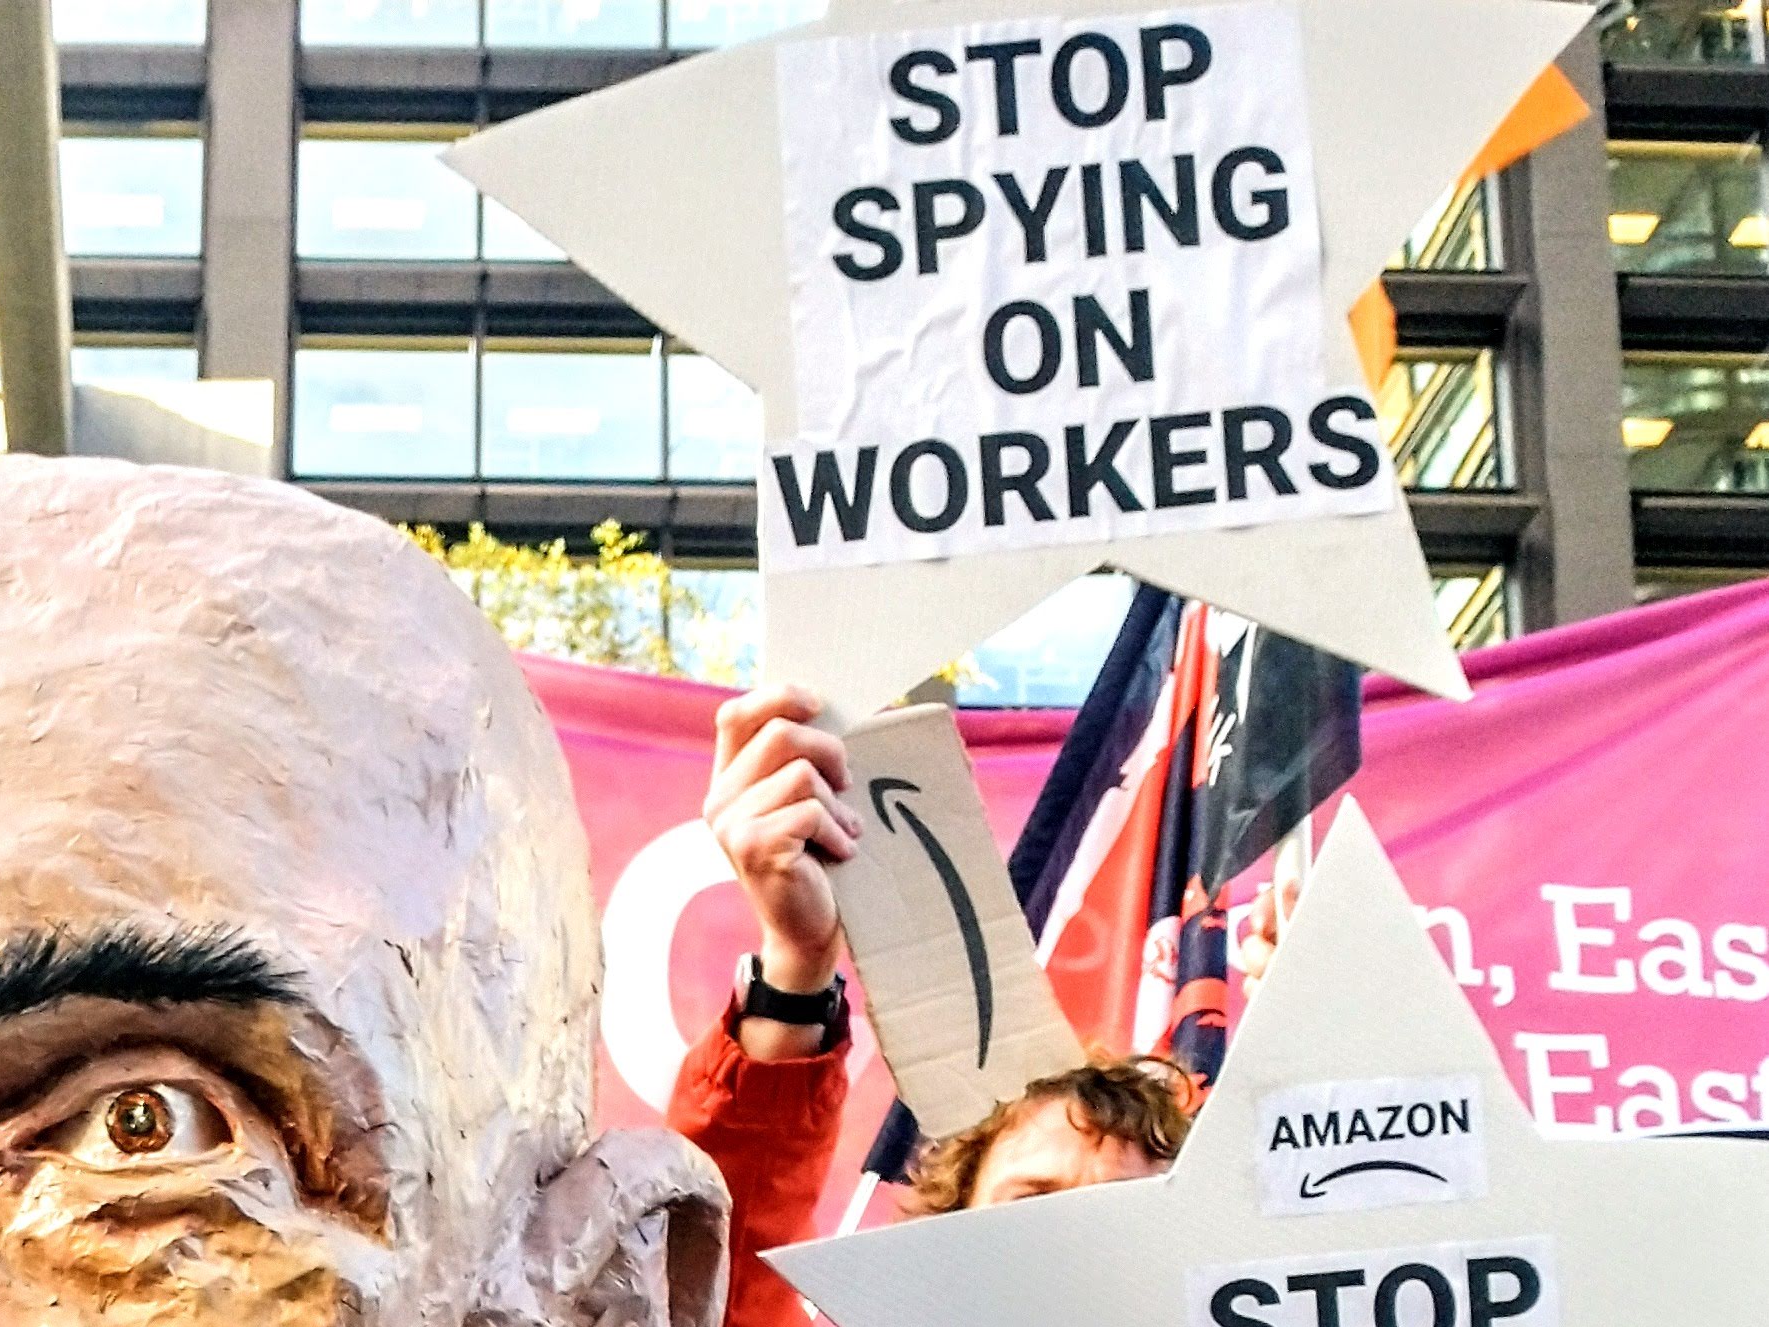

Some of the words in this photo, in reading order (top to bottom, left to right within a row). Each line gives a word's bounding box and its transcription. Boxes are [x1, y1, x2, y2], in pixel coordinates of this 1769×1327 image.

[887, 22, 1213, 147] STOP
[831, 145, 1291, 283] SPYING
[982, 287, 1155, 396] ON
[770, 394, 1381, 548] WORKERS
[1268, 1098, 1471, 1153] AMAZON
